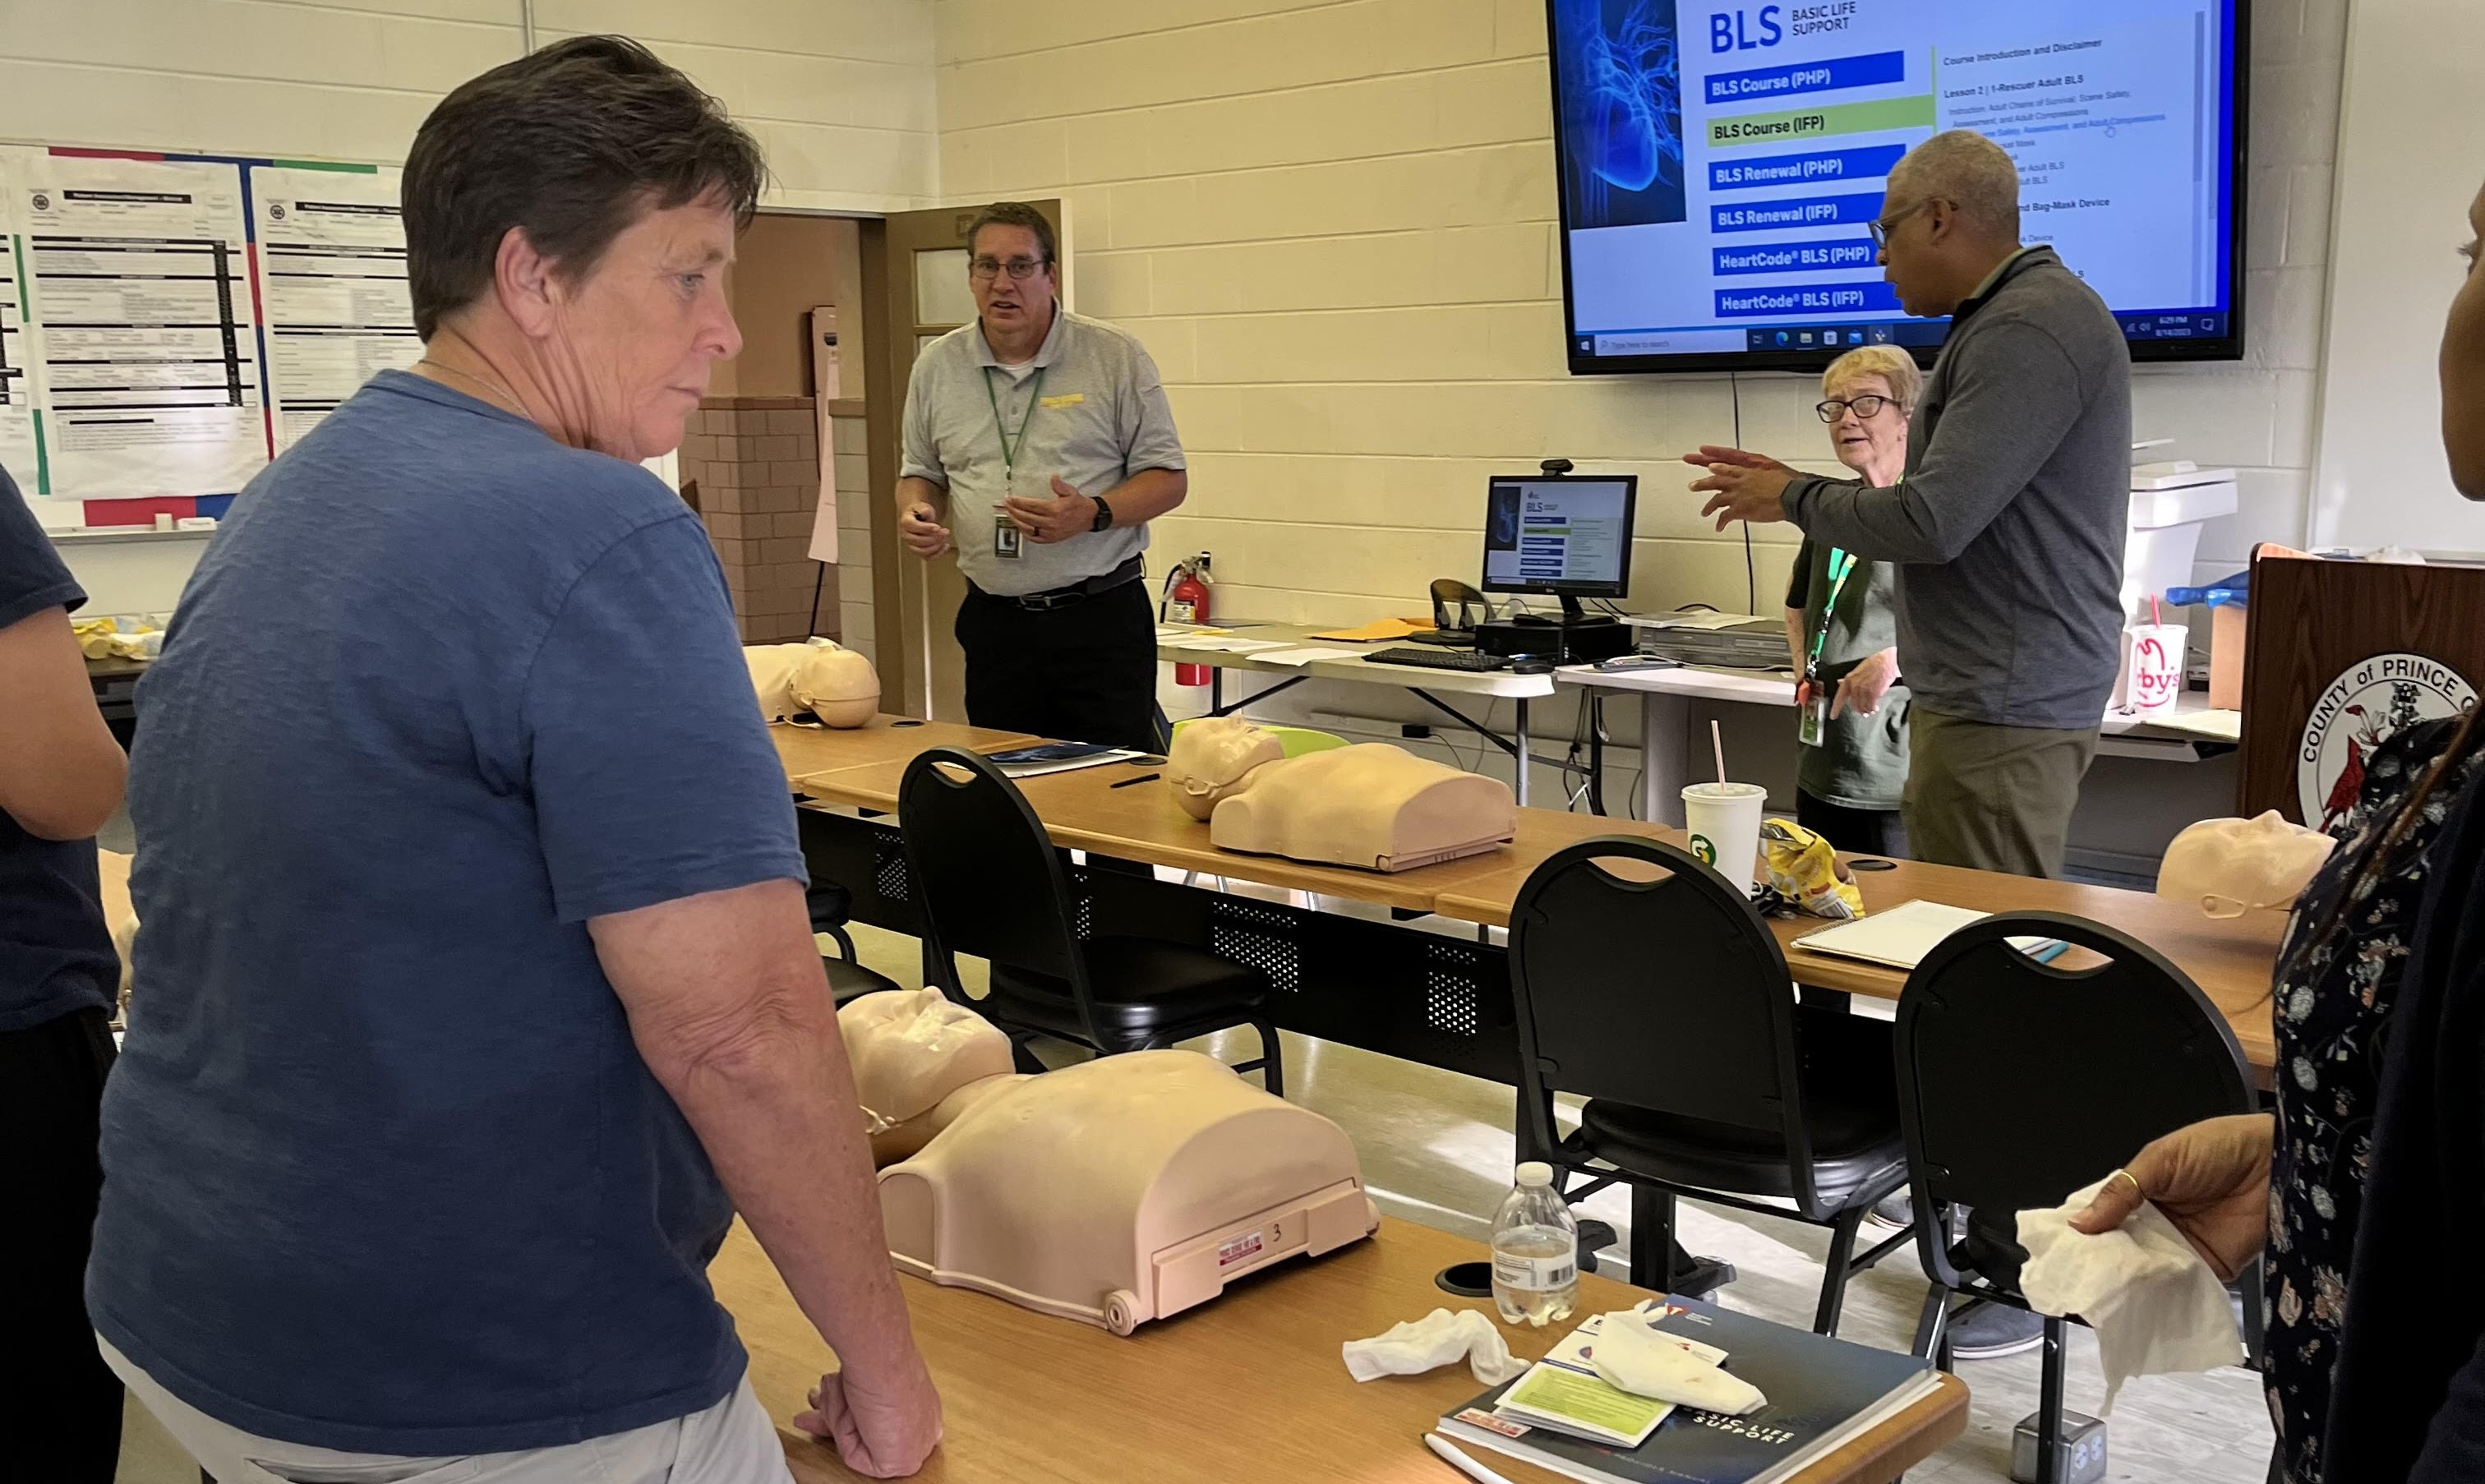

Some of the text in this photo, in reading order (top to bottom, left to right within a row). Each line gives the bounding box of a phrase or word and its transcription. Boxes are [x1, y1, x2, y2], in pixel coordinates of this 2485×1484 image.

[1792, 1, 1856, 22] BASIC LIFE
[1710, 5, 1782, 54] BLS
[1792, 16, 1850, 36] SUPPORT
[1943, 39, 2103, 66] Course Introduction and Disclaimer
[1712, 68, 1832, 96] BLS Course (PHP)
[1943, 88, 1976, 99] Lesson
[2038, 77, 2063, 87] Adult
[2064, 74, 2085, 85] BLS
[1714, 114, 1824, 140] BLS Course (IFP)
[1715, 158, 1843, 183] BLS Renewal (PHP)
[1717, 203, 1837, 226] BLS Renewal (IFP)
[2032, 200, 2076, 213] Bag-Mask
[2079, 198, 2110, 209] Device
[1801, 248, 1828, 264] BLS
[1831, 246, 1870, 264] (PHP)
[1803, 291, 1829, 307] BLS
[1832, 290, 1864, 308] (IFP)
[1526, 502, 1543, 513] BLS
[2303, 659, 2459, 763] COUNTY of PRINCE
[1692, 1416, 1788, 1445] SUPPORT
[1750, 1424, 1796, 1440] LIFE
